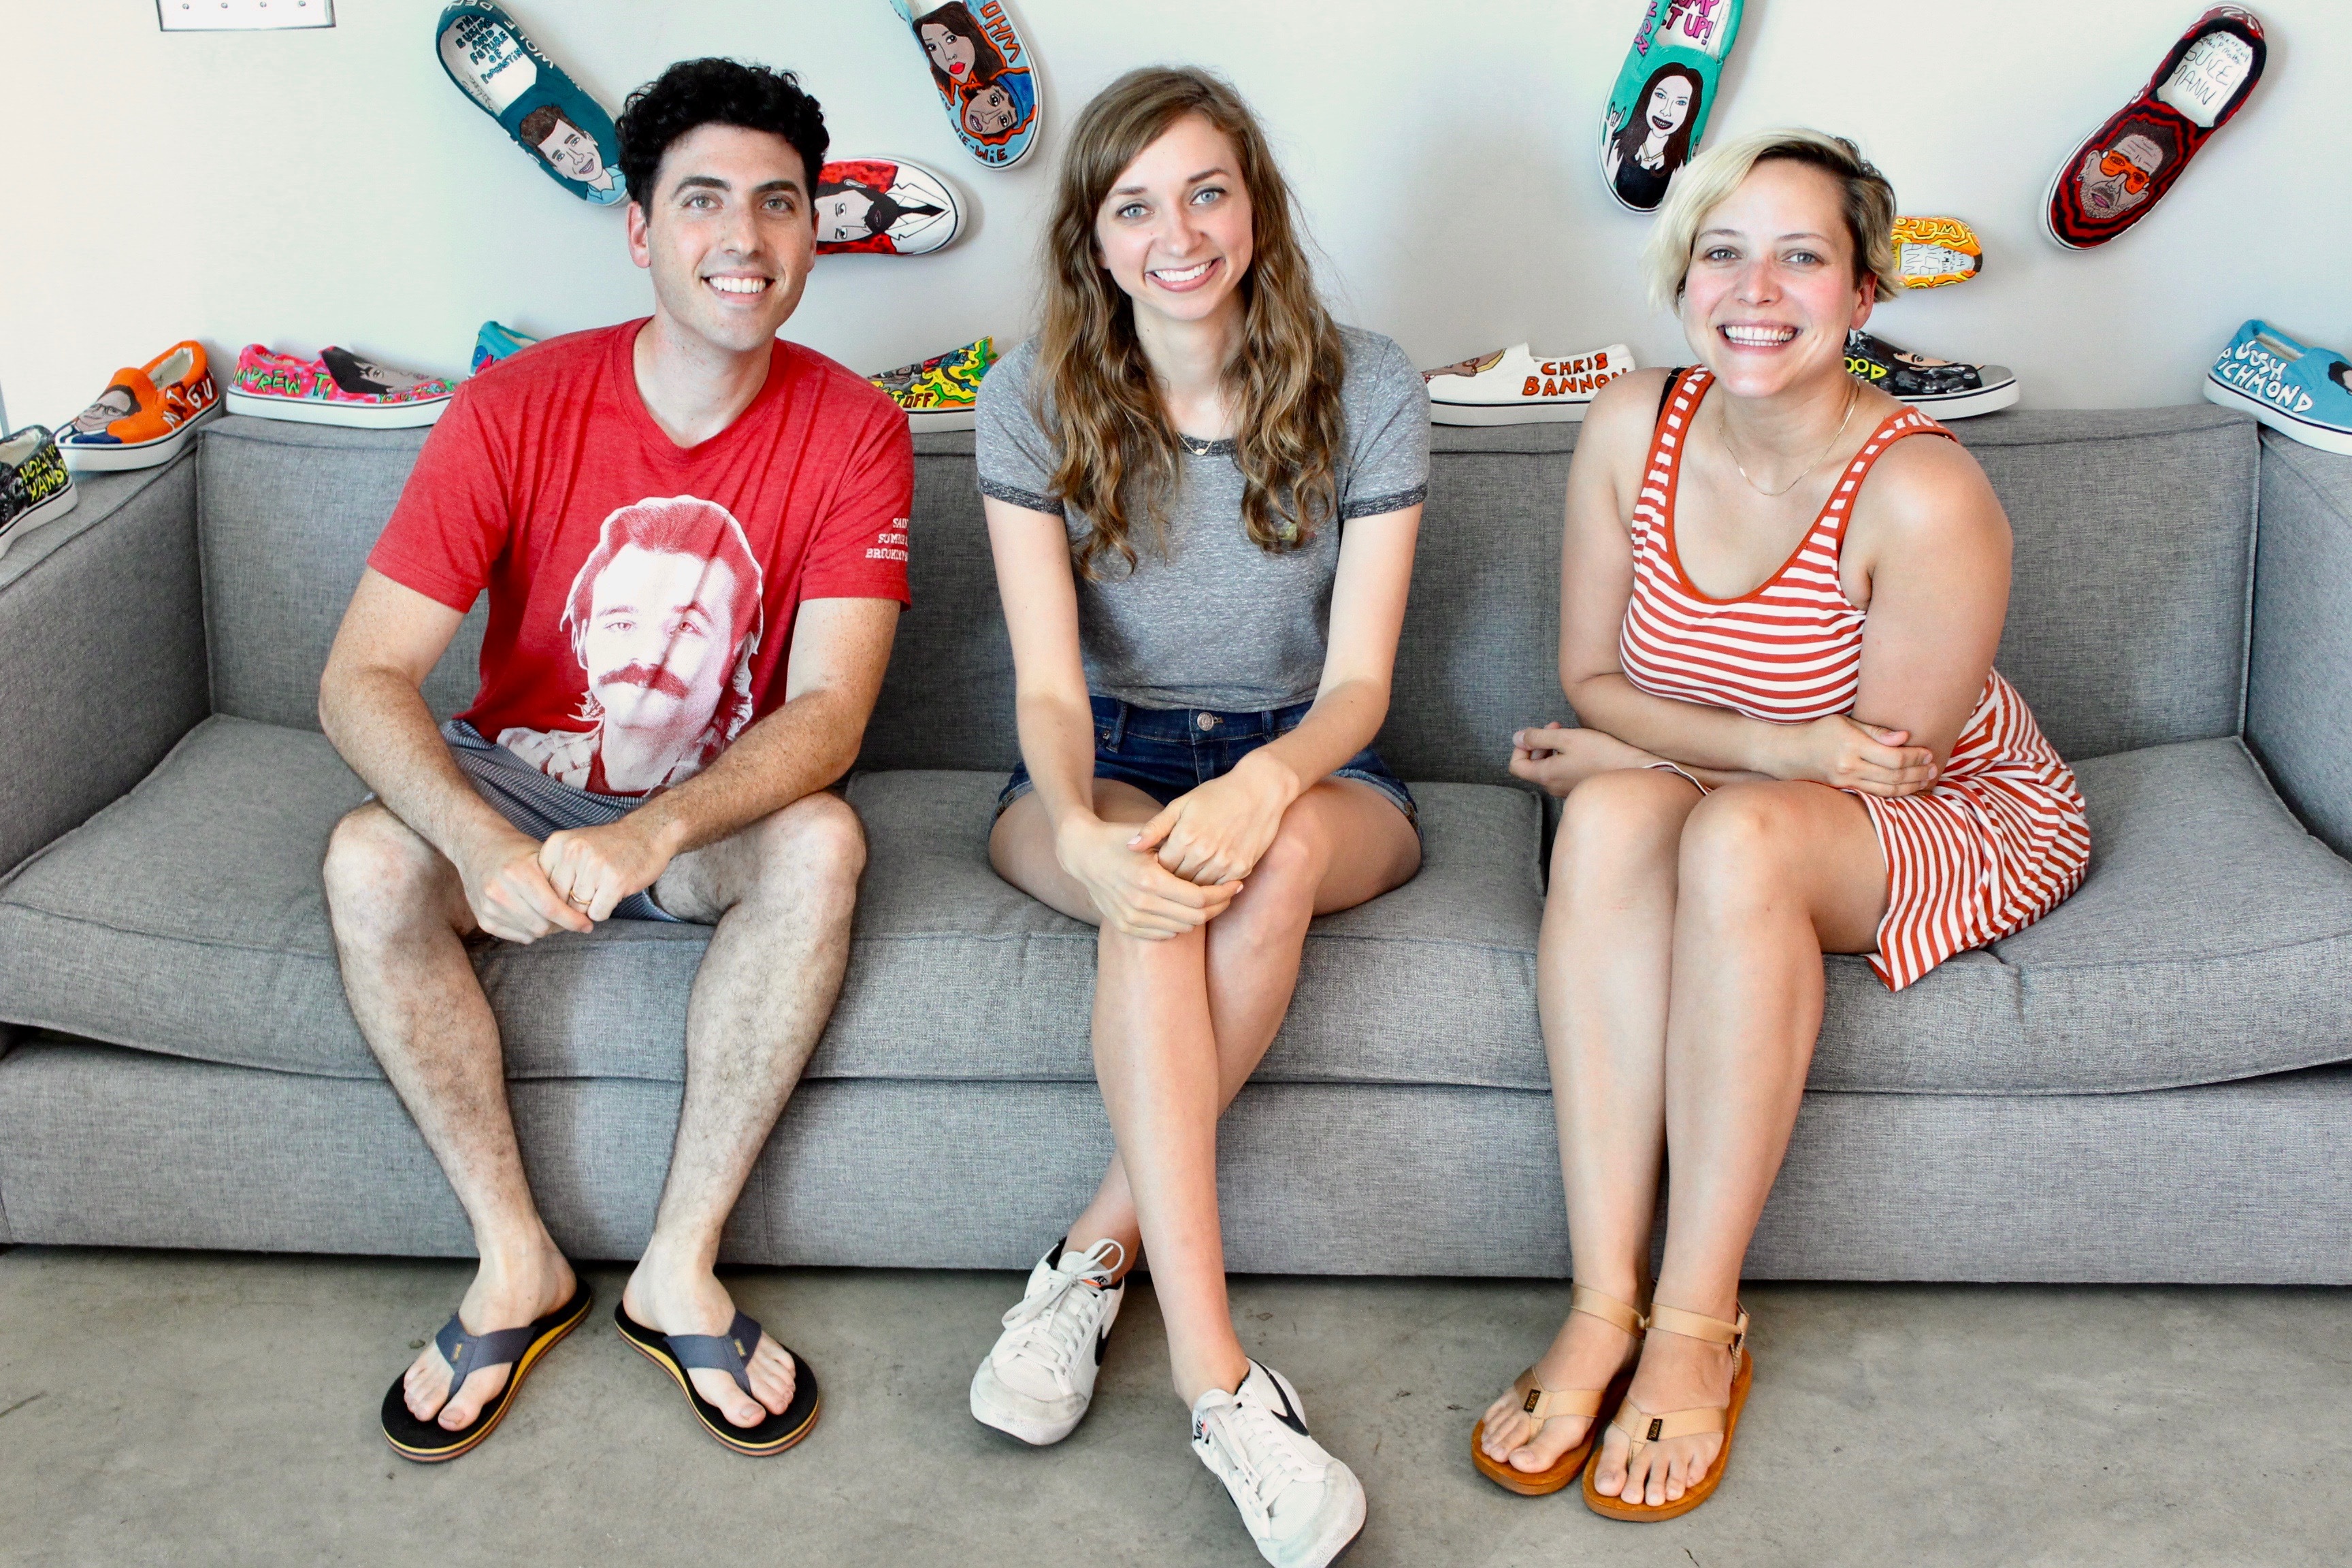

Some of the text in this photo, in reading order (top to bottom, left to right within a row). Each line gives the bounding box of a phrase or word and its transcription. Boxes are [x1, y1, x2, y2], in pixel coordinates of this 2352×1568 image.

[472, 29, 495, 51] AND
[979, 0, 1022, 63] WHO
[1683, 13, 1714, 46] UP!
[470, 31, 509, 66] FUTURE
[488, 48, 503, 63] OF
[233, 364, 301, 395] NDREW
[1541, 353, 1609, 376] CHRIS
